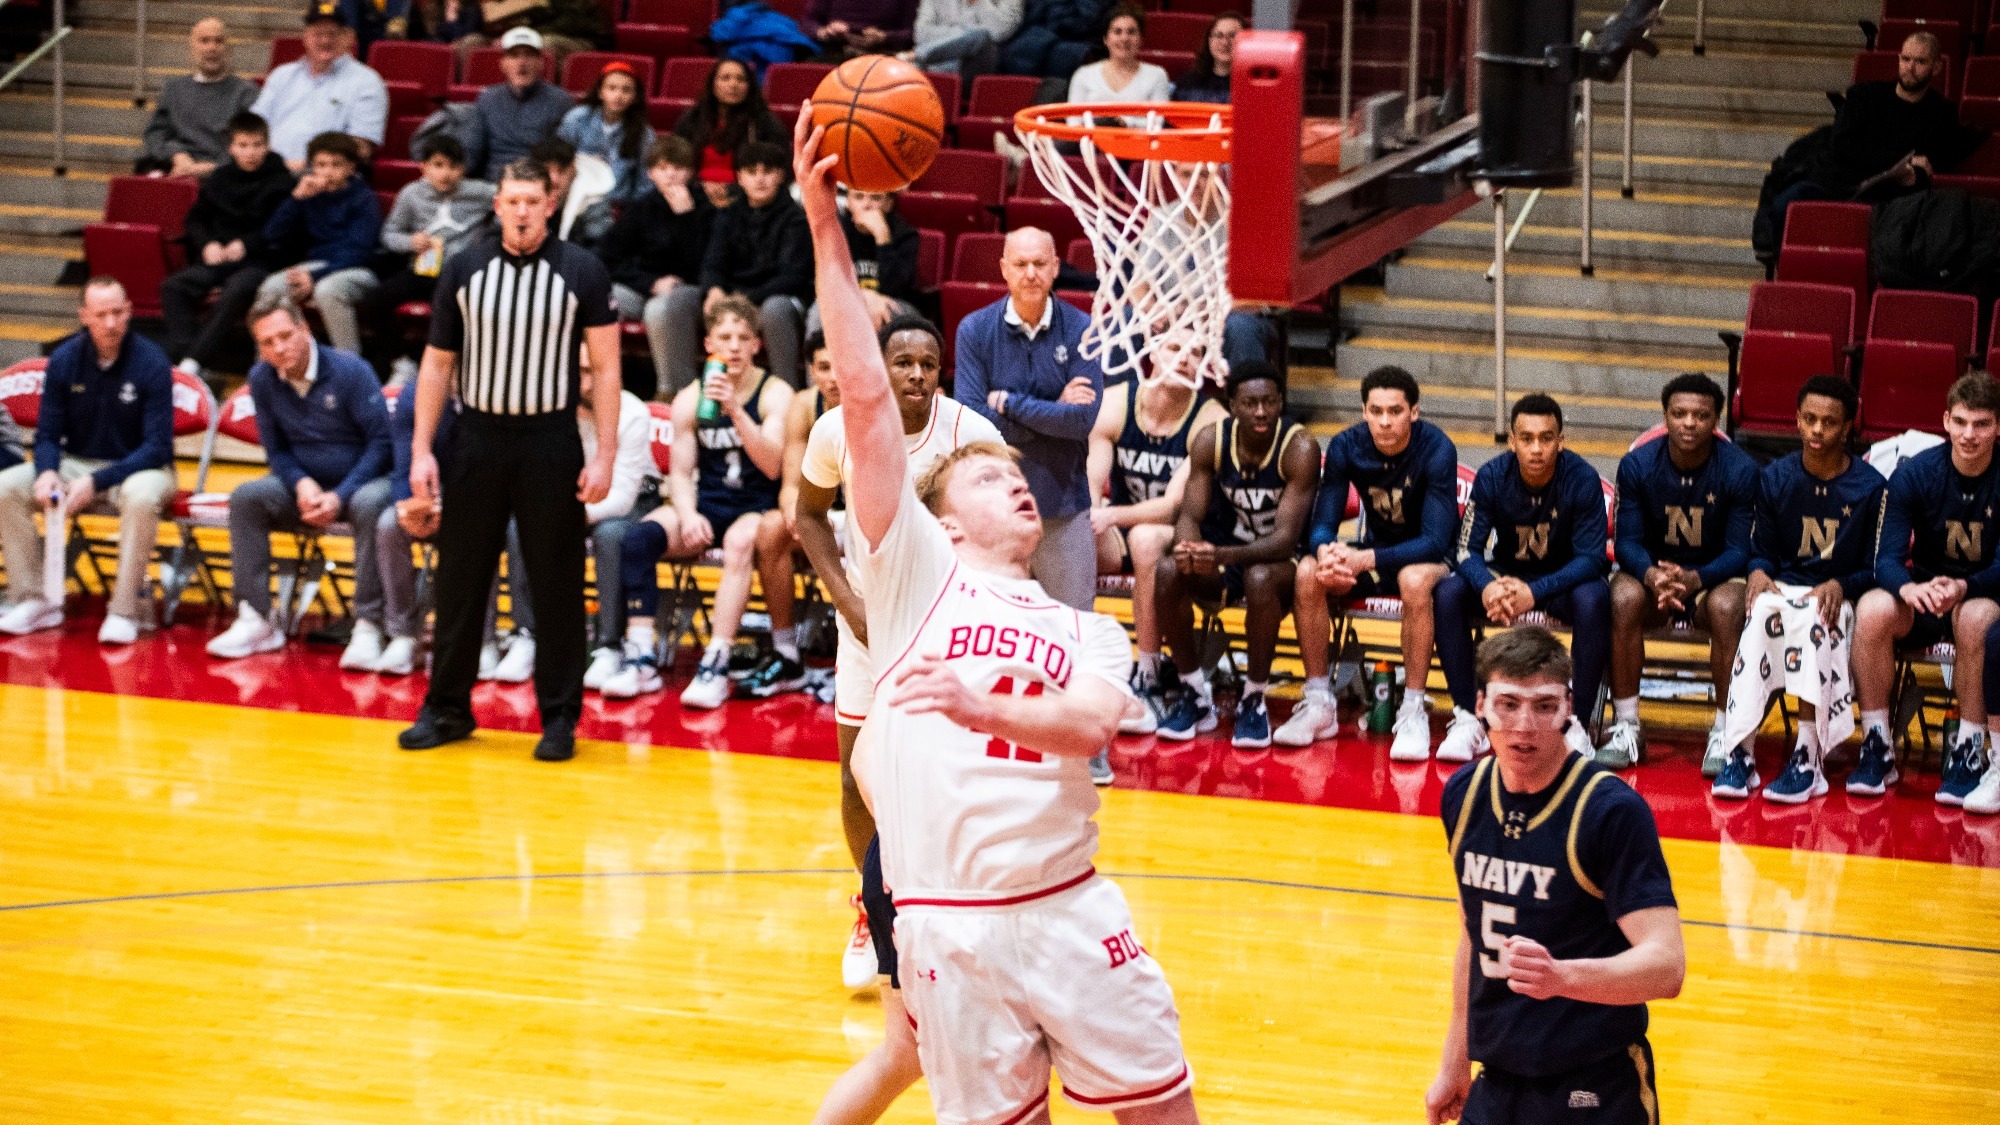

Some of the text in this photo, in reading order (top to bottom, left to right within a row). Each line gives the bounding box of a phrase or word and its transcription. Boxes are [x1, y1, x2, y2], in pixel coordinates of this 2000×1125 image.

[722, 451, 743, 488] 1
[1117, 447, 1189, 477] NAVY
[1515, 522, 1550, 561] N
[1664, 505, 1704, 547] N
[1797, 516, 1840, 560] N
[1945, 520, 1984, 562] N
[944, 624, 1073, 689] BOSTO
[1785, 646, 1802, 673] G
[1375, 683, 1389, 701] G
[1461, 851, 1556, 900] NAVY
[1479, 901, 1517, 979] 5
